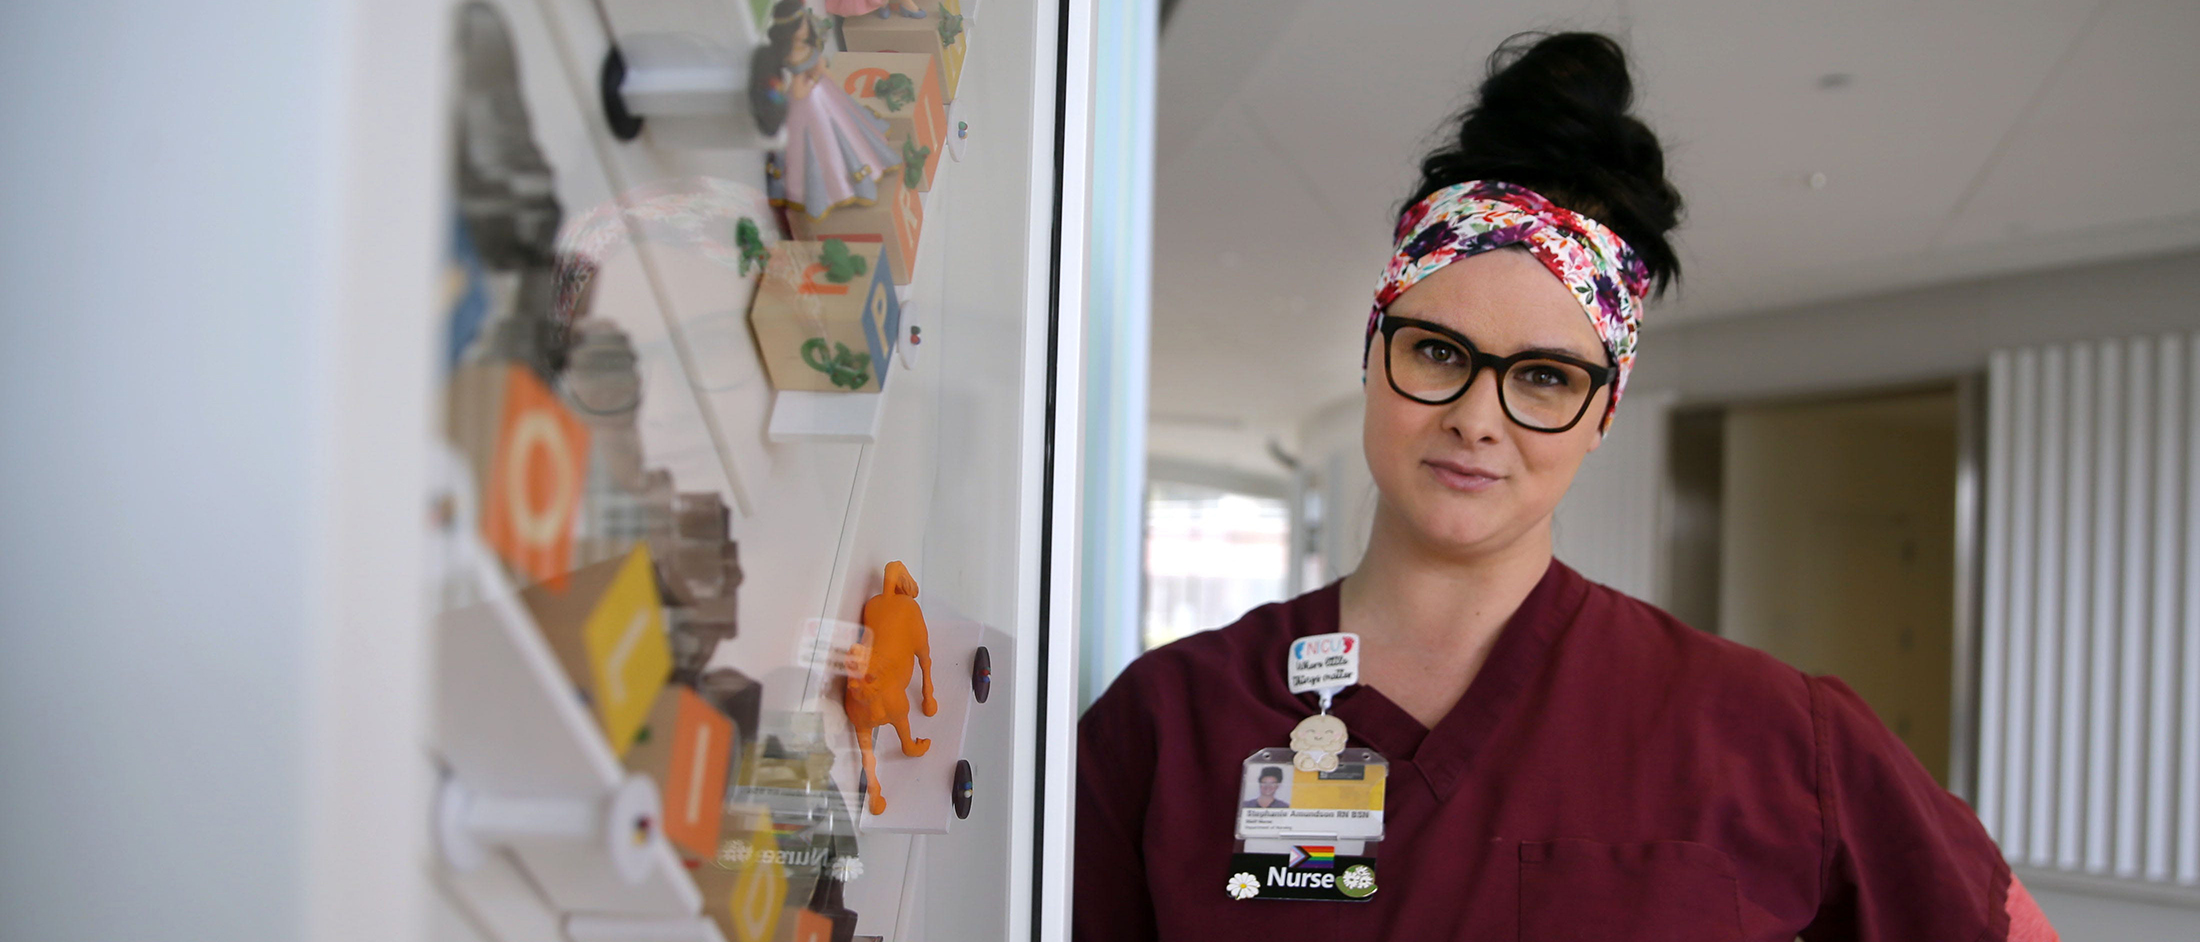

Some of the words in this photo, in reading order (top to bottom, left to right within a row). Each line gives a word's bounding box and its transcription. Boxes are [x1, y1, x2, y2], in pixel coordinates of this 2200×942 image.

[870, 281, 889, 359] P
[507, 410, 575, 550] O
[1306, 638, 1341, 655] NICU
[1266, 866, 1335, 889] Nurse
